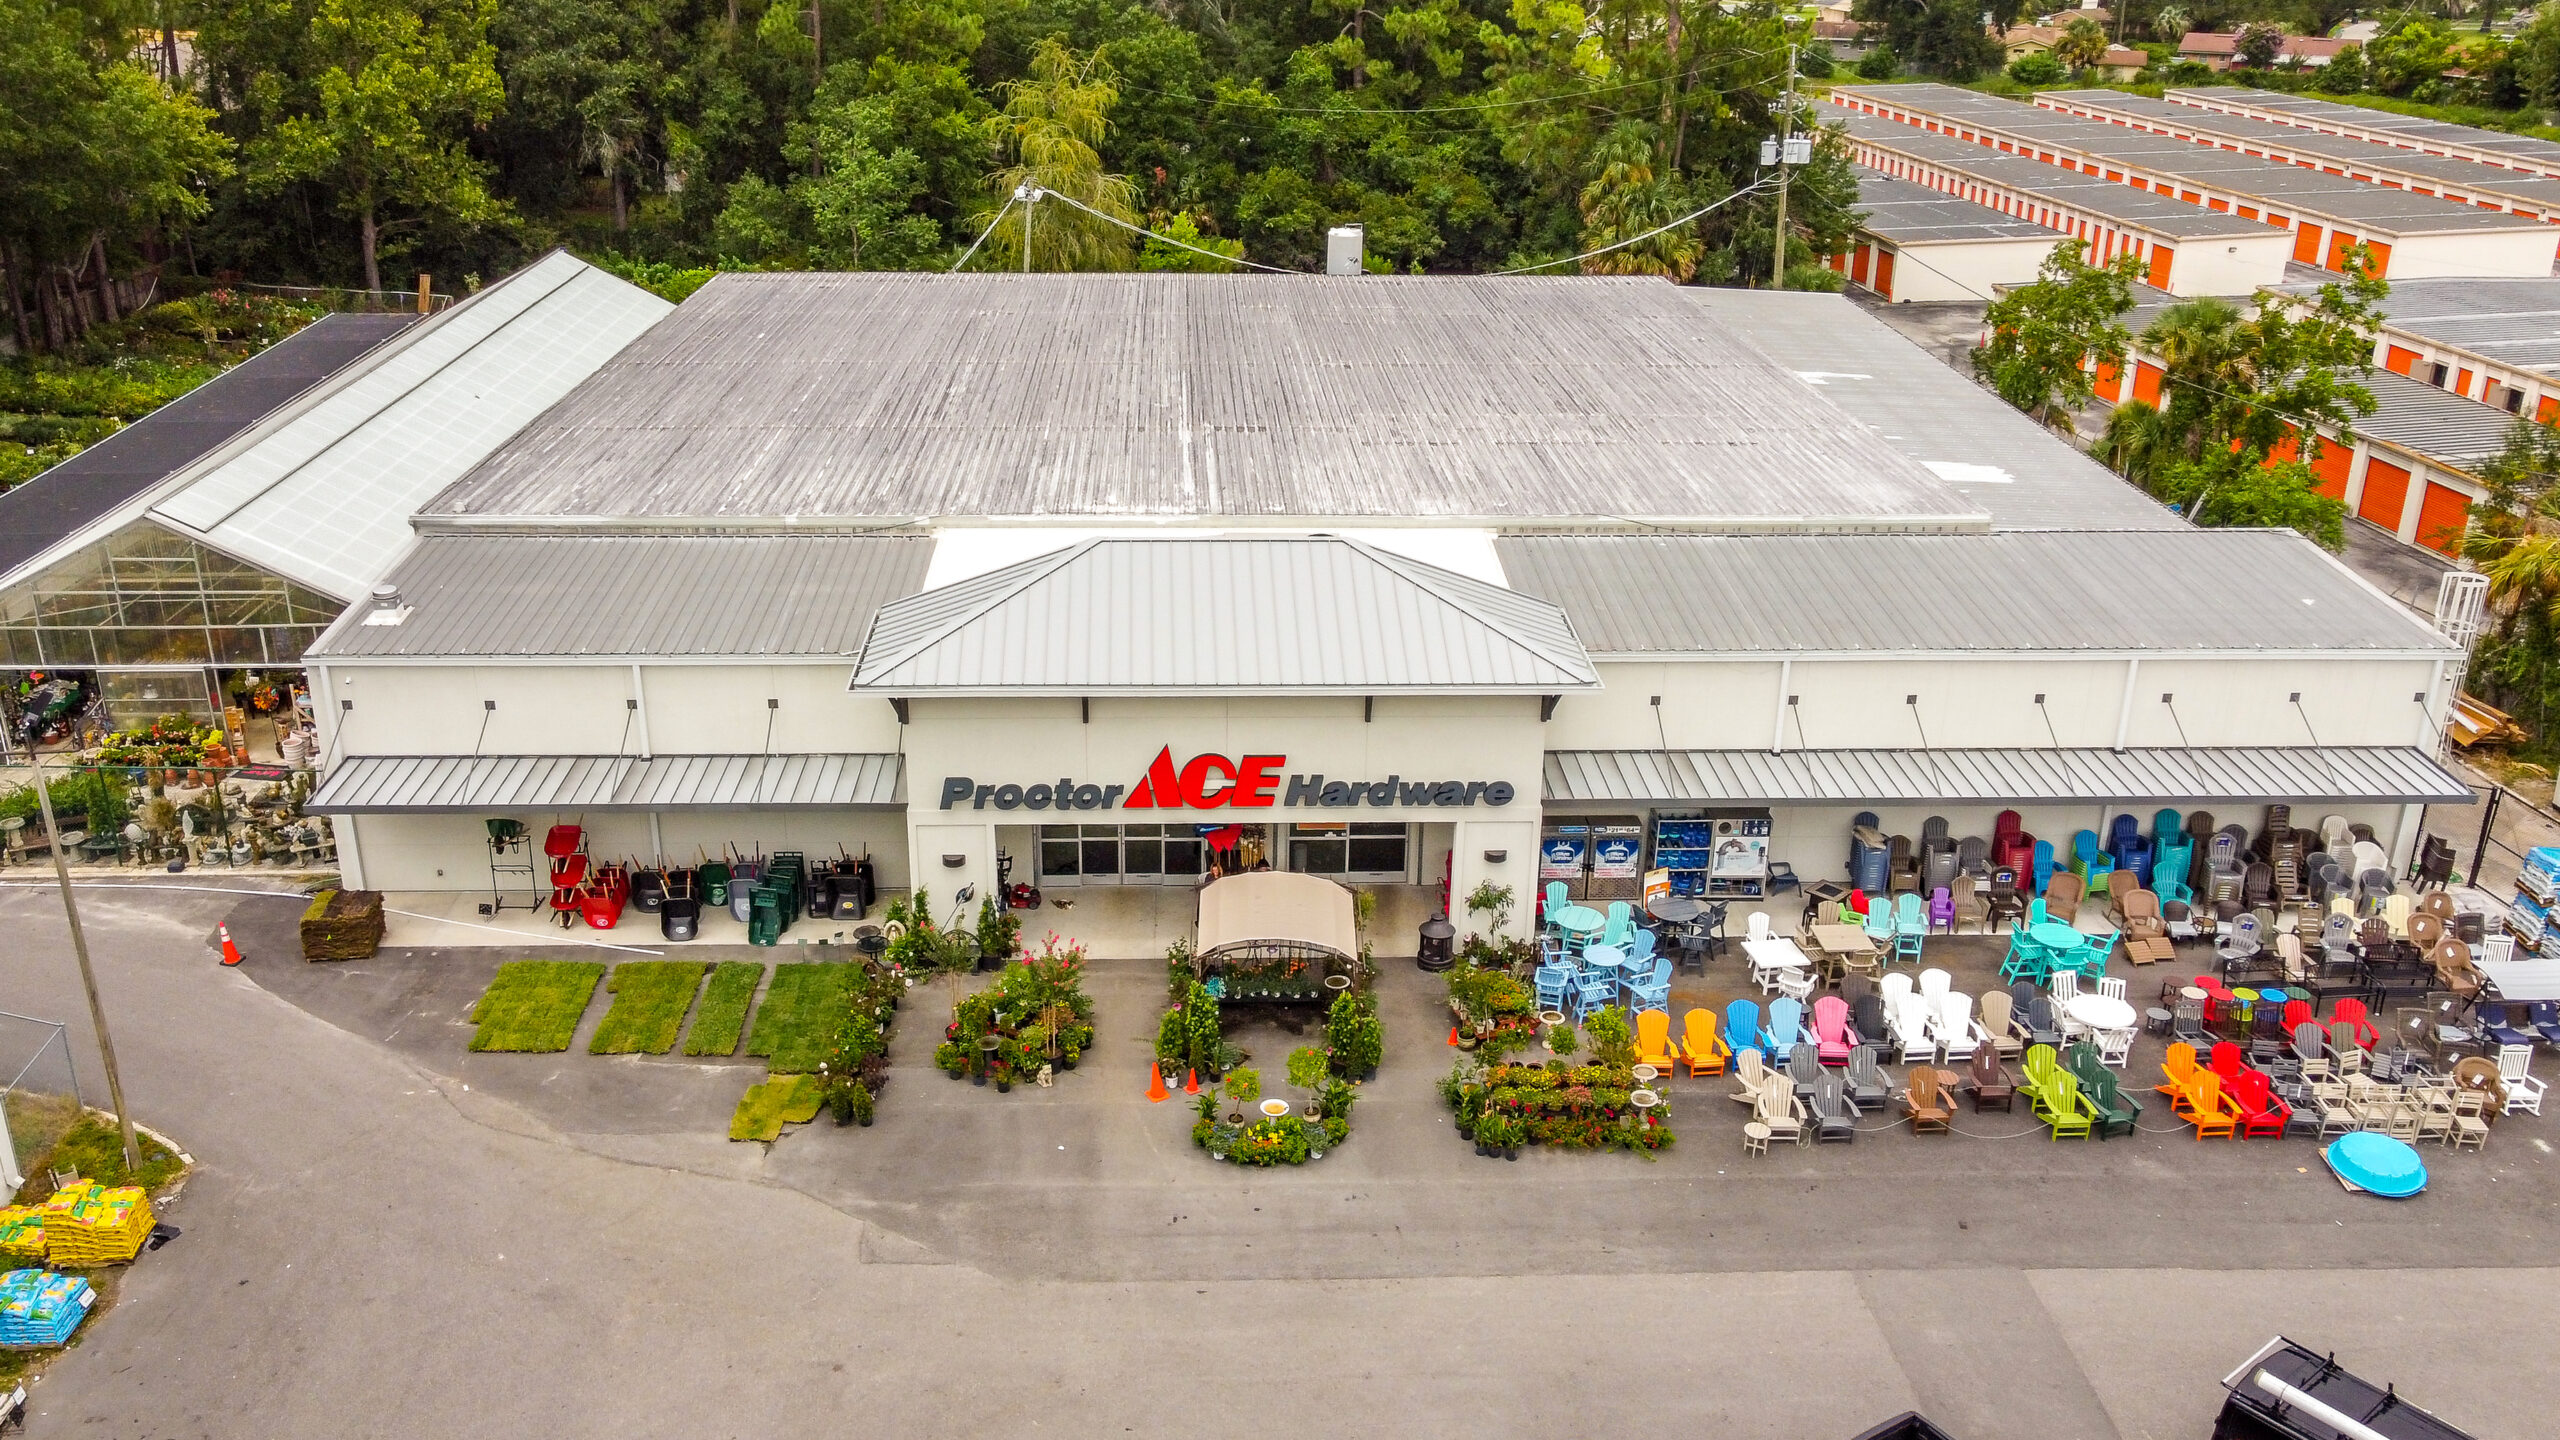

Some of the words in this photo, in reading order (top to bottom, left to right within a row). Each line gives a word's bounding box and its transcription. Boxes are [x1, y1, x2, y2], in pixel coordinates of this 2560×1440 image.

[940, 777, 1124, 811] Proctor
[1123, 744, 1287, 810] ACE
[1284, 774, 1515, 807] Hardware
